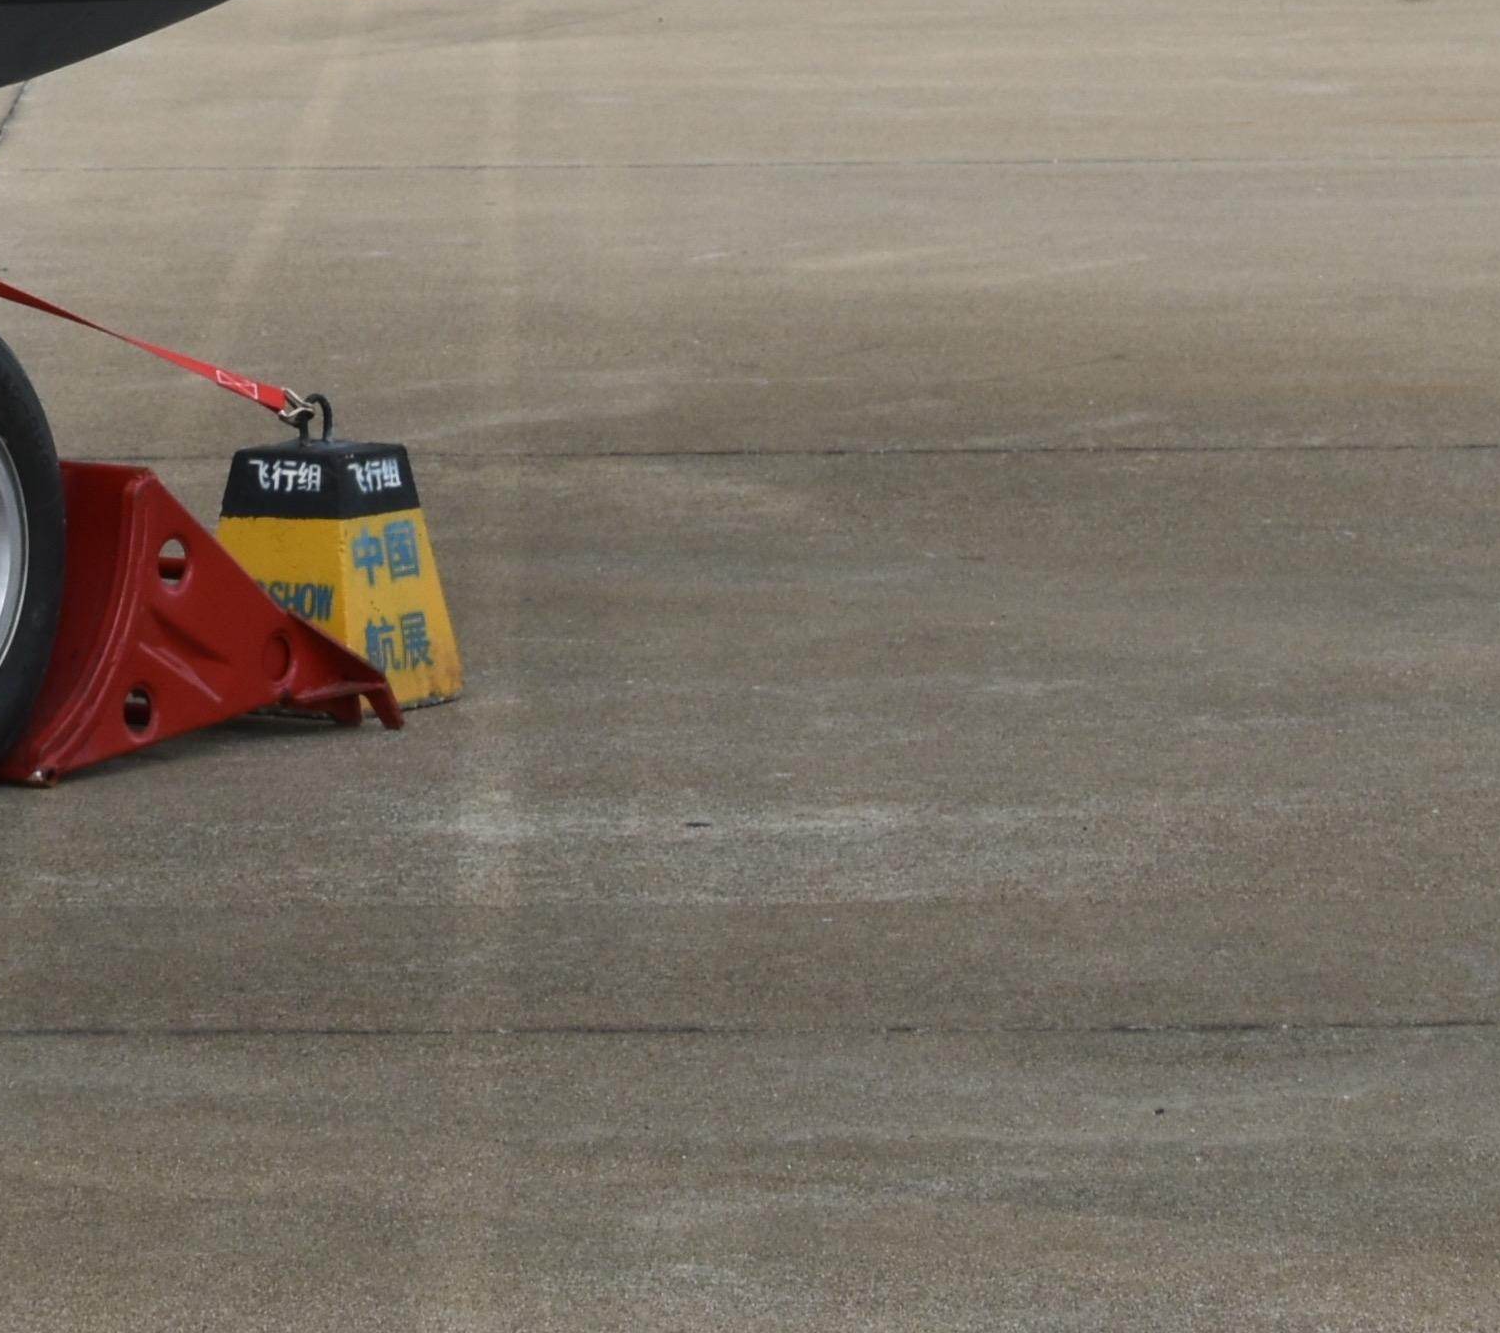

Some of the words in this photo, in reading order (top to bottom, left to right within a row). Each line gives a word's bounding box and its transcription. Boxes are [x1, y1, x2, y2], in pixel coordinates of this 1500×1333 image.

[249, 459, 323, 493] 飞行组
[346, 457, 402, 493] 飞行组
[351, 519, 421, 587] 中国
[255, 579, 336, 622] SHOW
[364, 611, 434, 672] 航展
